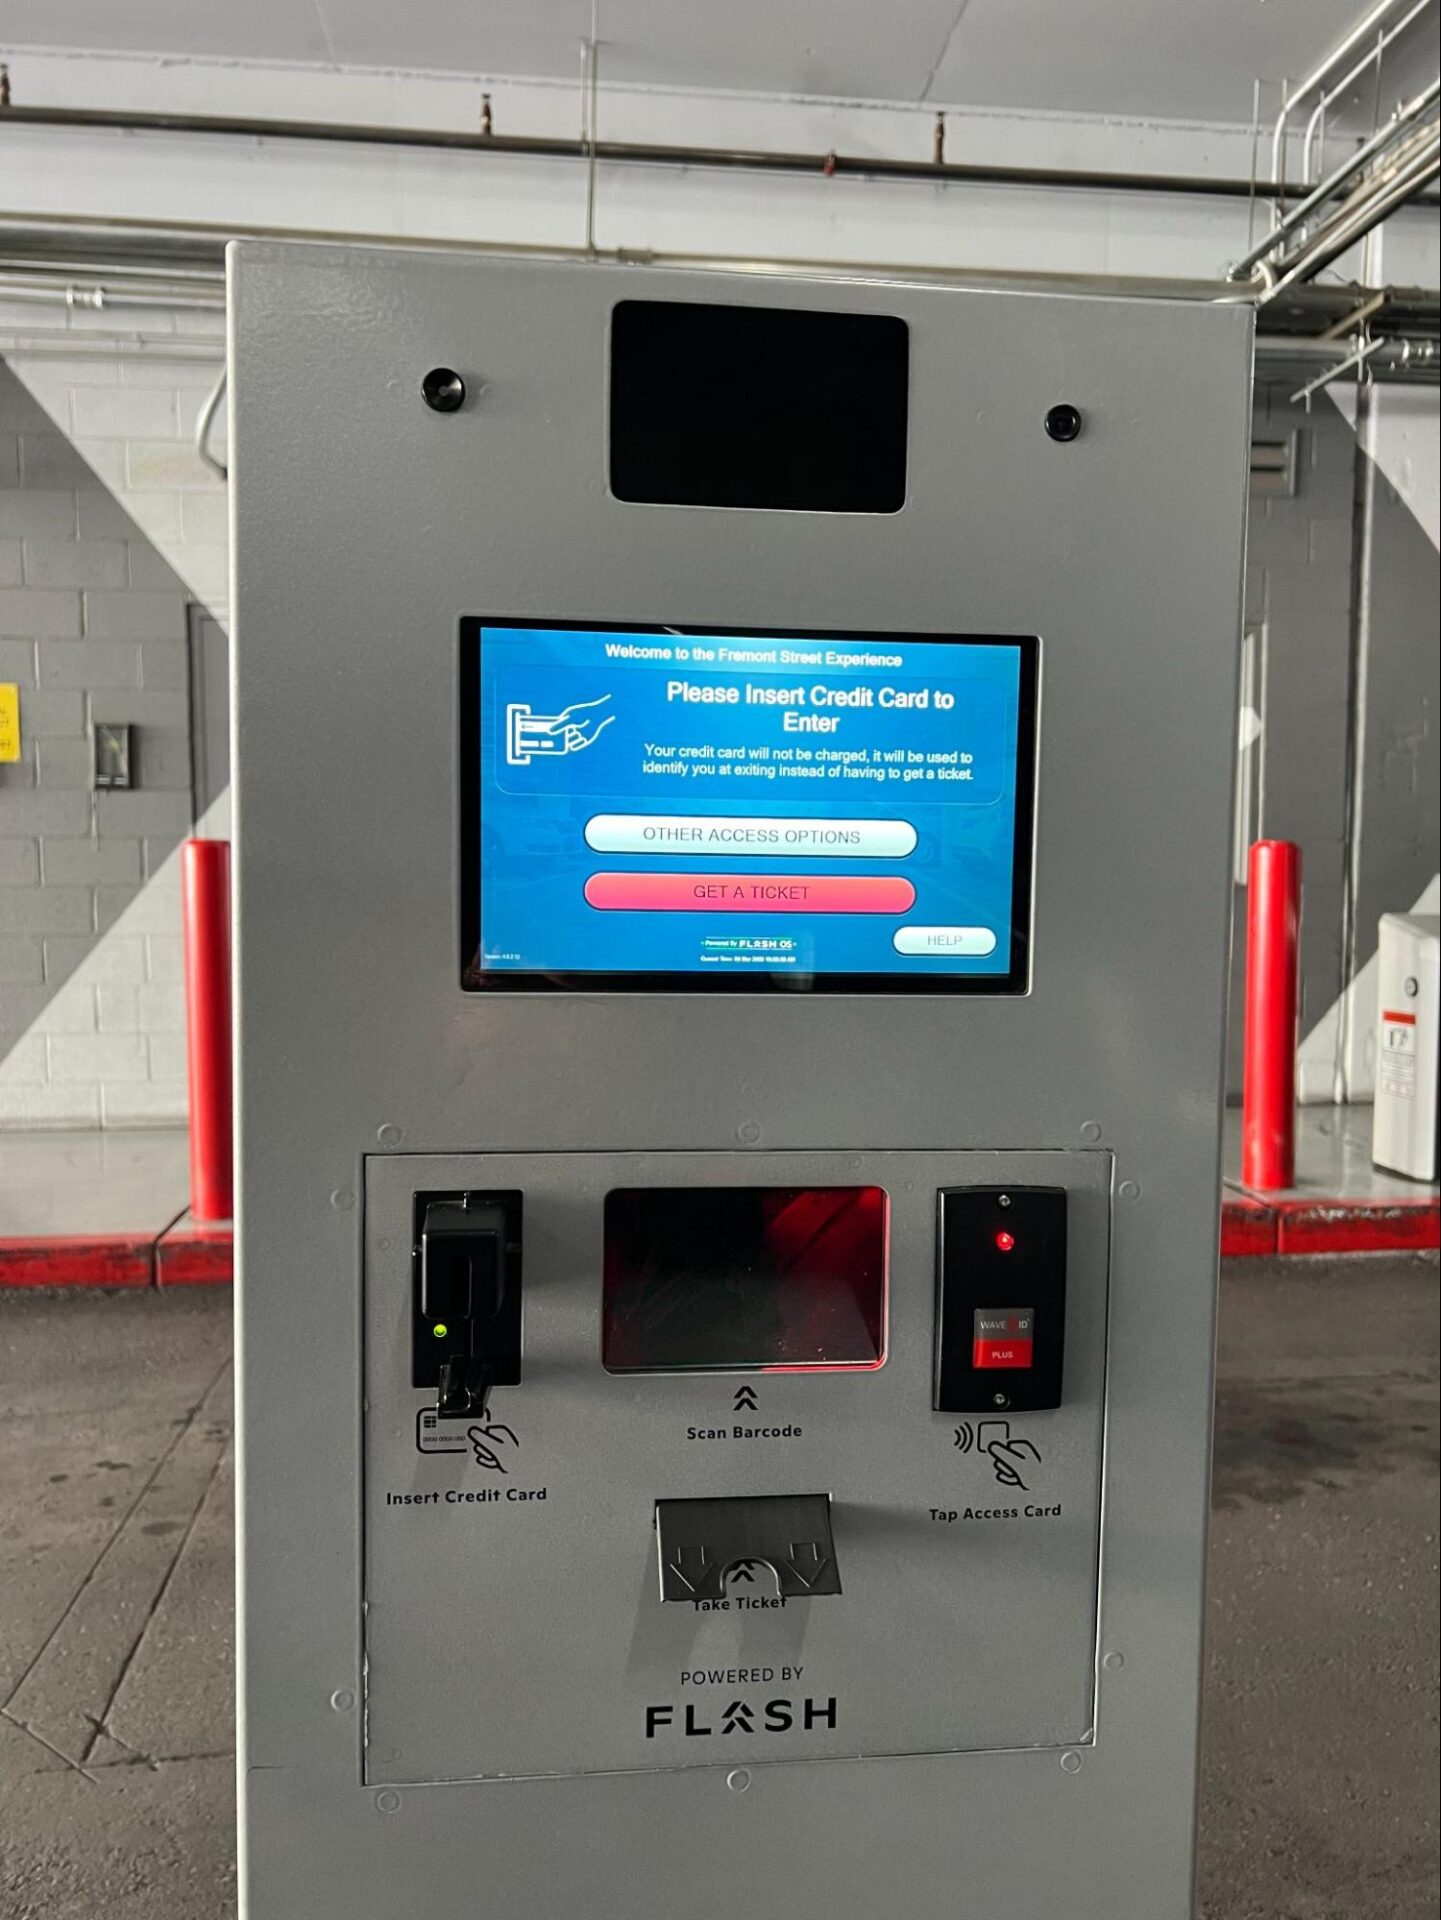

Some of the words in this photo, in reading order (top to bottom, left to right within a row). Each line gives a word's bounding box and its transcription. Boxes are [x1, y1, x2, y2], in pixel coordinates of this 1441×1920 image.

[605, 643, 672, 660] Welcome
[674, 646, 690, 660] to
[692, 647, 715, 661] the
[718, 647, 777, 664] Fremont
[780, 650, 823, 665] Street
[825, 651, 903, 668] Experience
[667, 681, 740, 704] Please
[745, 683, 806, 705] Insert
[809, 685, 874, 707] Credit
[878, 687, 929, 709] Card
[933, 690, 955, 710] to
[783, 711, 840, 733] Enter
[644, 743, 677, 757] Your
[678, 745, 714, 758] credit
[717, 746, 746, 759] card
[748, 747, 769, 760] will
[772, 748, 793, 761] not
[795, 748, 812, 761] be
[815, 749, 870, 764] charged,
[873, 750, 881, 763] it
[884, 750, 905, 763] will
[907, 750, 924, 763] be
[927, 751, 958, 764] used
[960, 752, 973, 764] to
[642, 760, 689, 777] identify
[692, 763, 716, 778] you
[718, 763, 732, 776] at
[734, 763, 776, 780] exiting
[779, 764, 825, 778] instead
[827, 765, 842, 778] of
[843, 766, 886, 782] having
[888, 767, 901, 780] to
[903, 768, 924, 782] get
[926, 769, 934, 780] a
[937, 768, 974, 781] ticket.
[643, 826, 703, 841] OTHER
[708, 828, 779, 843] ACCESS
[785, 829, 861, 845] OPTIONS
[693, 884, 729, 899] GET
[733, 886, 745, 899] A
[751, 885, 811, 900] TICKET
[739, 939, 777, 949] FLASH
[779, 940, 792, 949] OS
[927, 934, 964, 947] HELP
[980, 1319, 1007, 1330] WAVE
[991, 1351, 1013, 1360] PLUS
[686, 1426, 727, 1440] Scan
[732, 1424, 803, 1439] Barcode
[386, 1491, 440, 1506] Insert
[444, 1488, 501, 1504] Credit
[506, 1487, 547, 1502] Card
[928, 1508, 958, 1523] Tap
[962, 1506, 1019, 1520] Access
[1023, 1503, 1062, 1518] Card
[691, 1597, 730, 1612] Take
[735, 1596, 788, 1610] Ticket
[680, 1667, 775, 1686] POWERED
[781, 1665, 804, 1681] BY
[645, 1696, 837, 1739] FLASH
